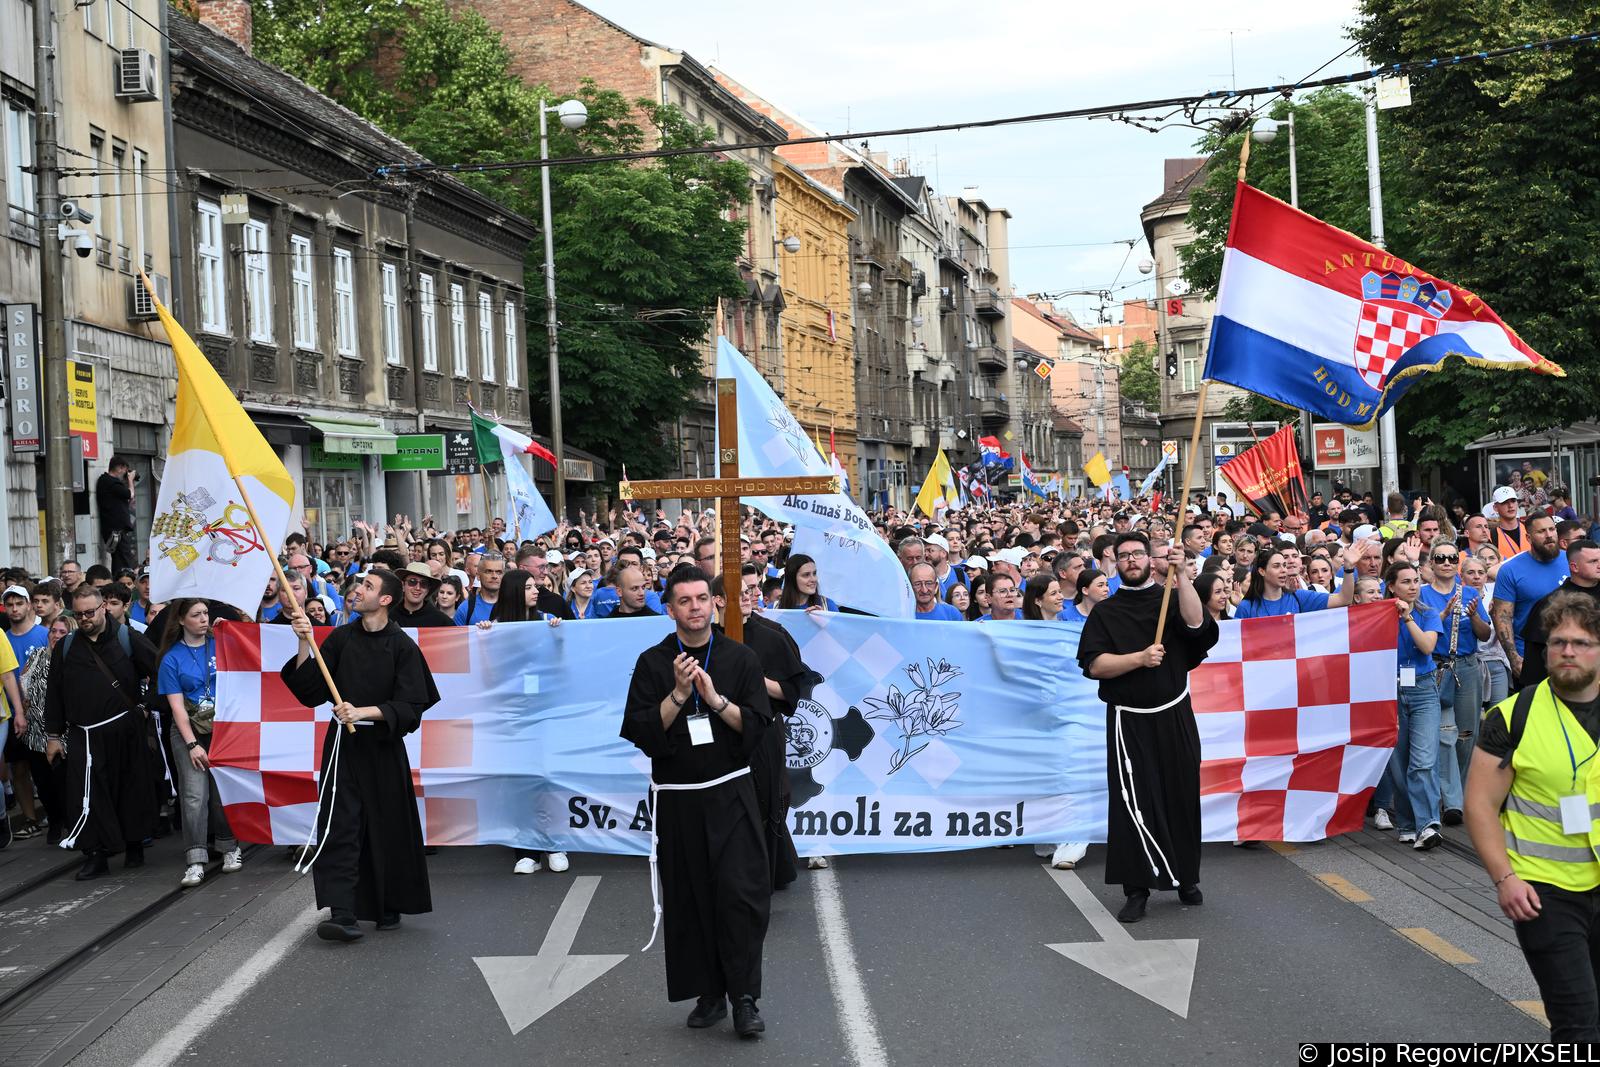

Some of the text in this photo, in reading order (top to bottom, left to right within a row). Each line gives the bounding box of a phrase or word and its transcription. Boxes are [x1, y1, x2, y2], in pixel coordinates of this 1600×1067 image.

[1170, 300, 1179, 315] S
[13, 310, 33, 436] SREBRO
[1313, 366, 1351, 408] HOD
[75, 388, 88, 399] SERVIS
[633, 480, 829, 495] ANTUNOVSKI HOD MLADIH
[783, 494, 872, 531] Ako imaš Boga,
[789, 749, 824, 768] MLADIH
[568, 796, 618, 830] Sv.
[792, 796, 882, 836] moli
[893, 811, 933, 837] za
[945, 801, 1025, 837] nas!
